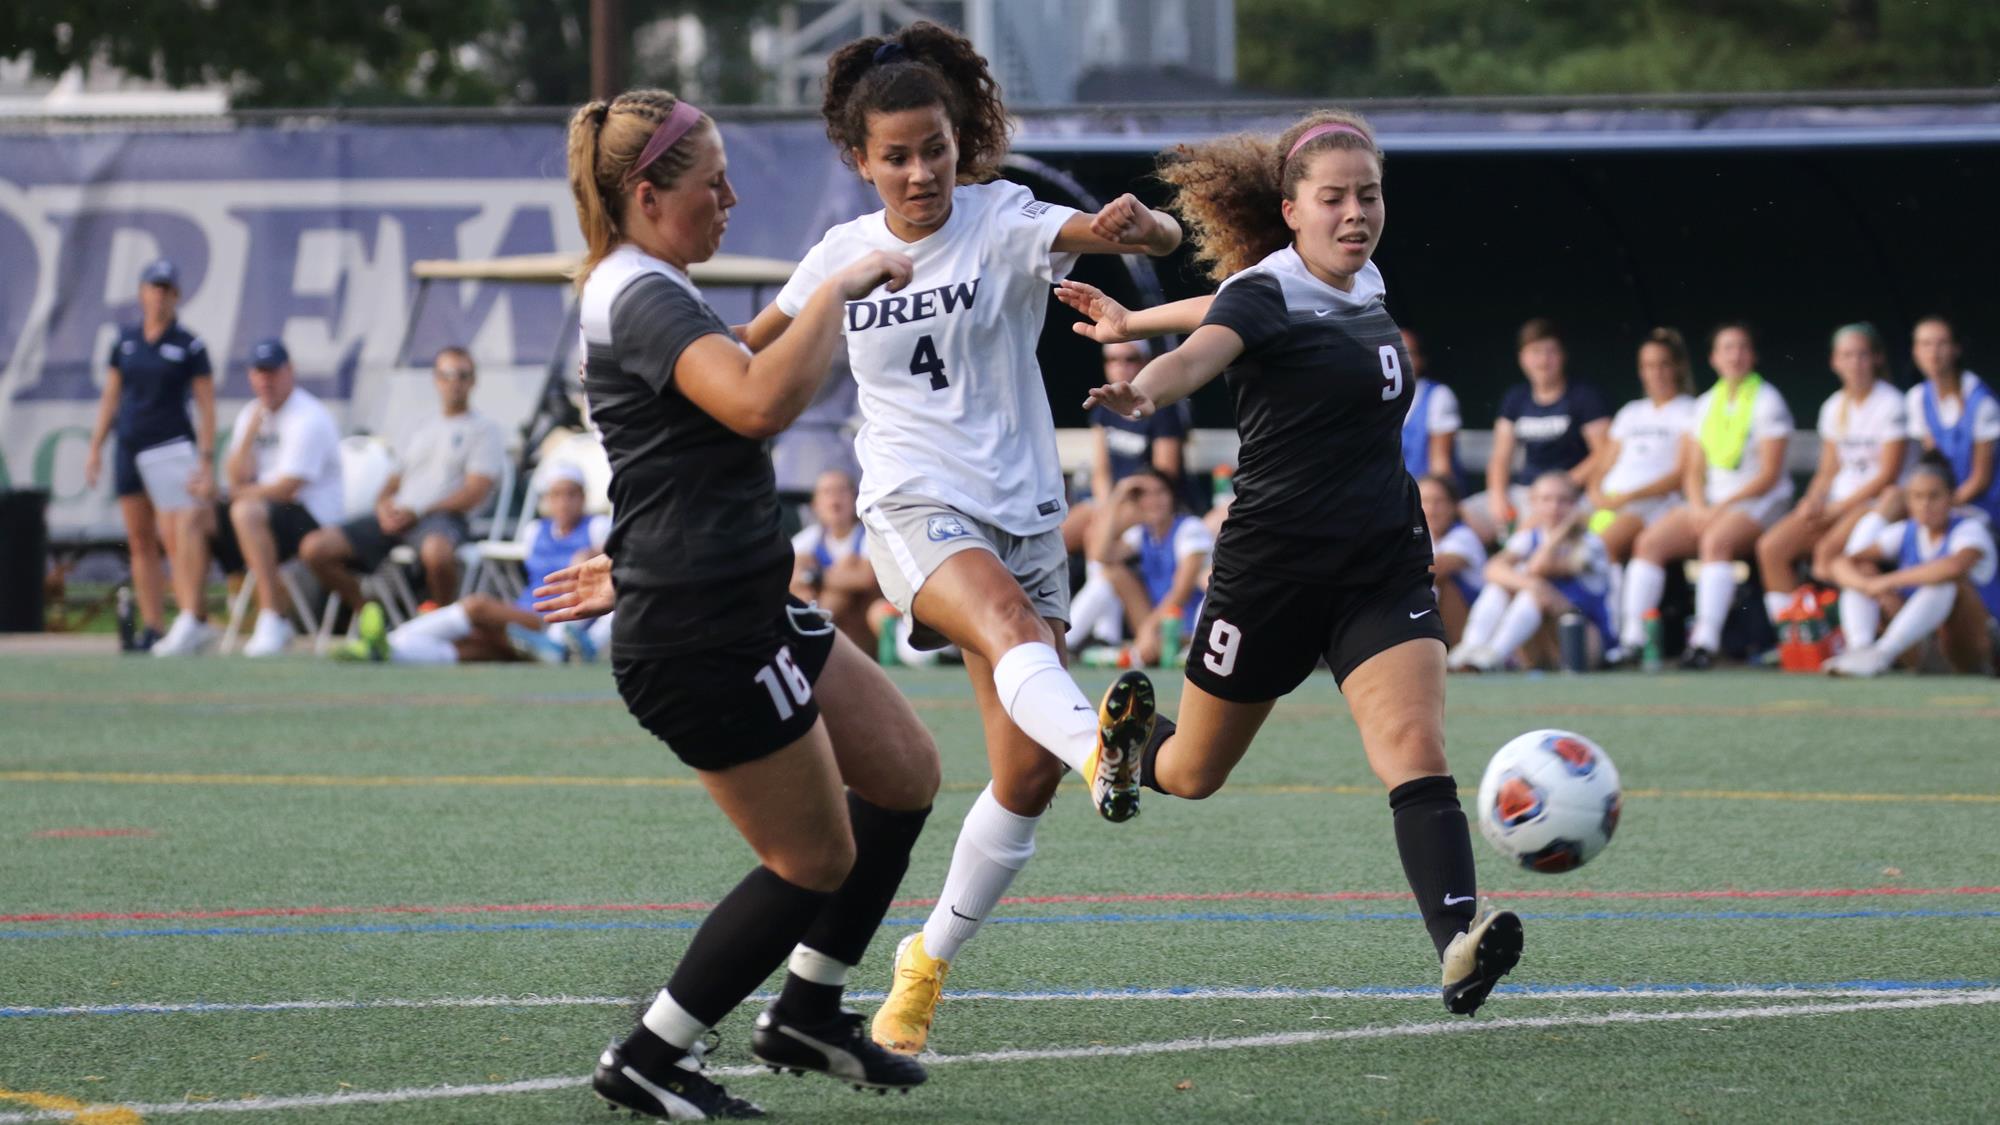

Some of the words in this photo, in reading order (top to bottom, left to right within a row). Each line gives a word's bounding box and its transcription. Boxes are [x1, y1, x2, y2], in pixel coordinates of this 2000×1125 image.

[0, 182, 580, 404] REW
[845, 277, 982, 332] DREW
[909, 335, 950, 391] 4
[1378, 345, 1403, 401] 9
[1203, 618, 1242, 677] 9
[754, 645, 812, 721] 16
